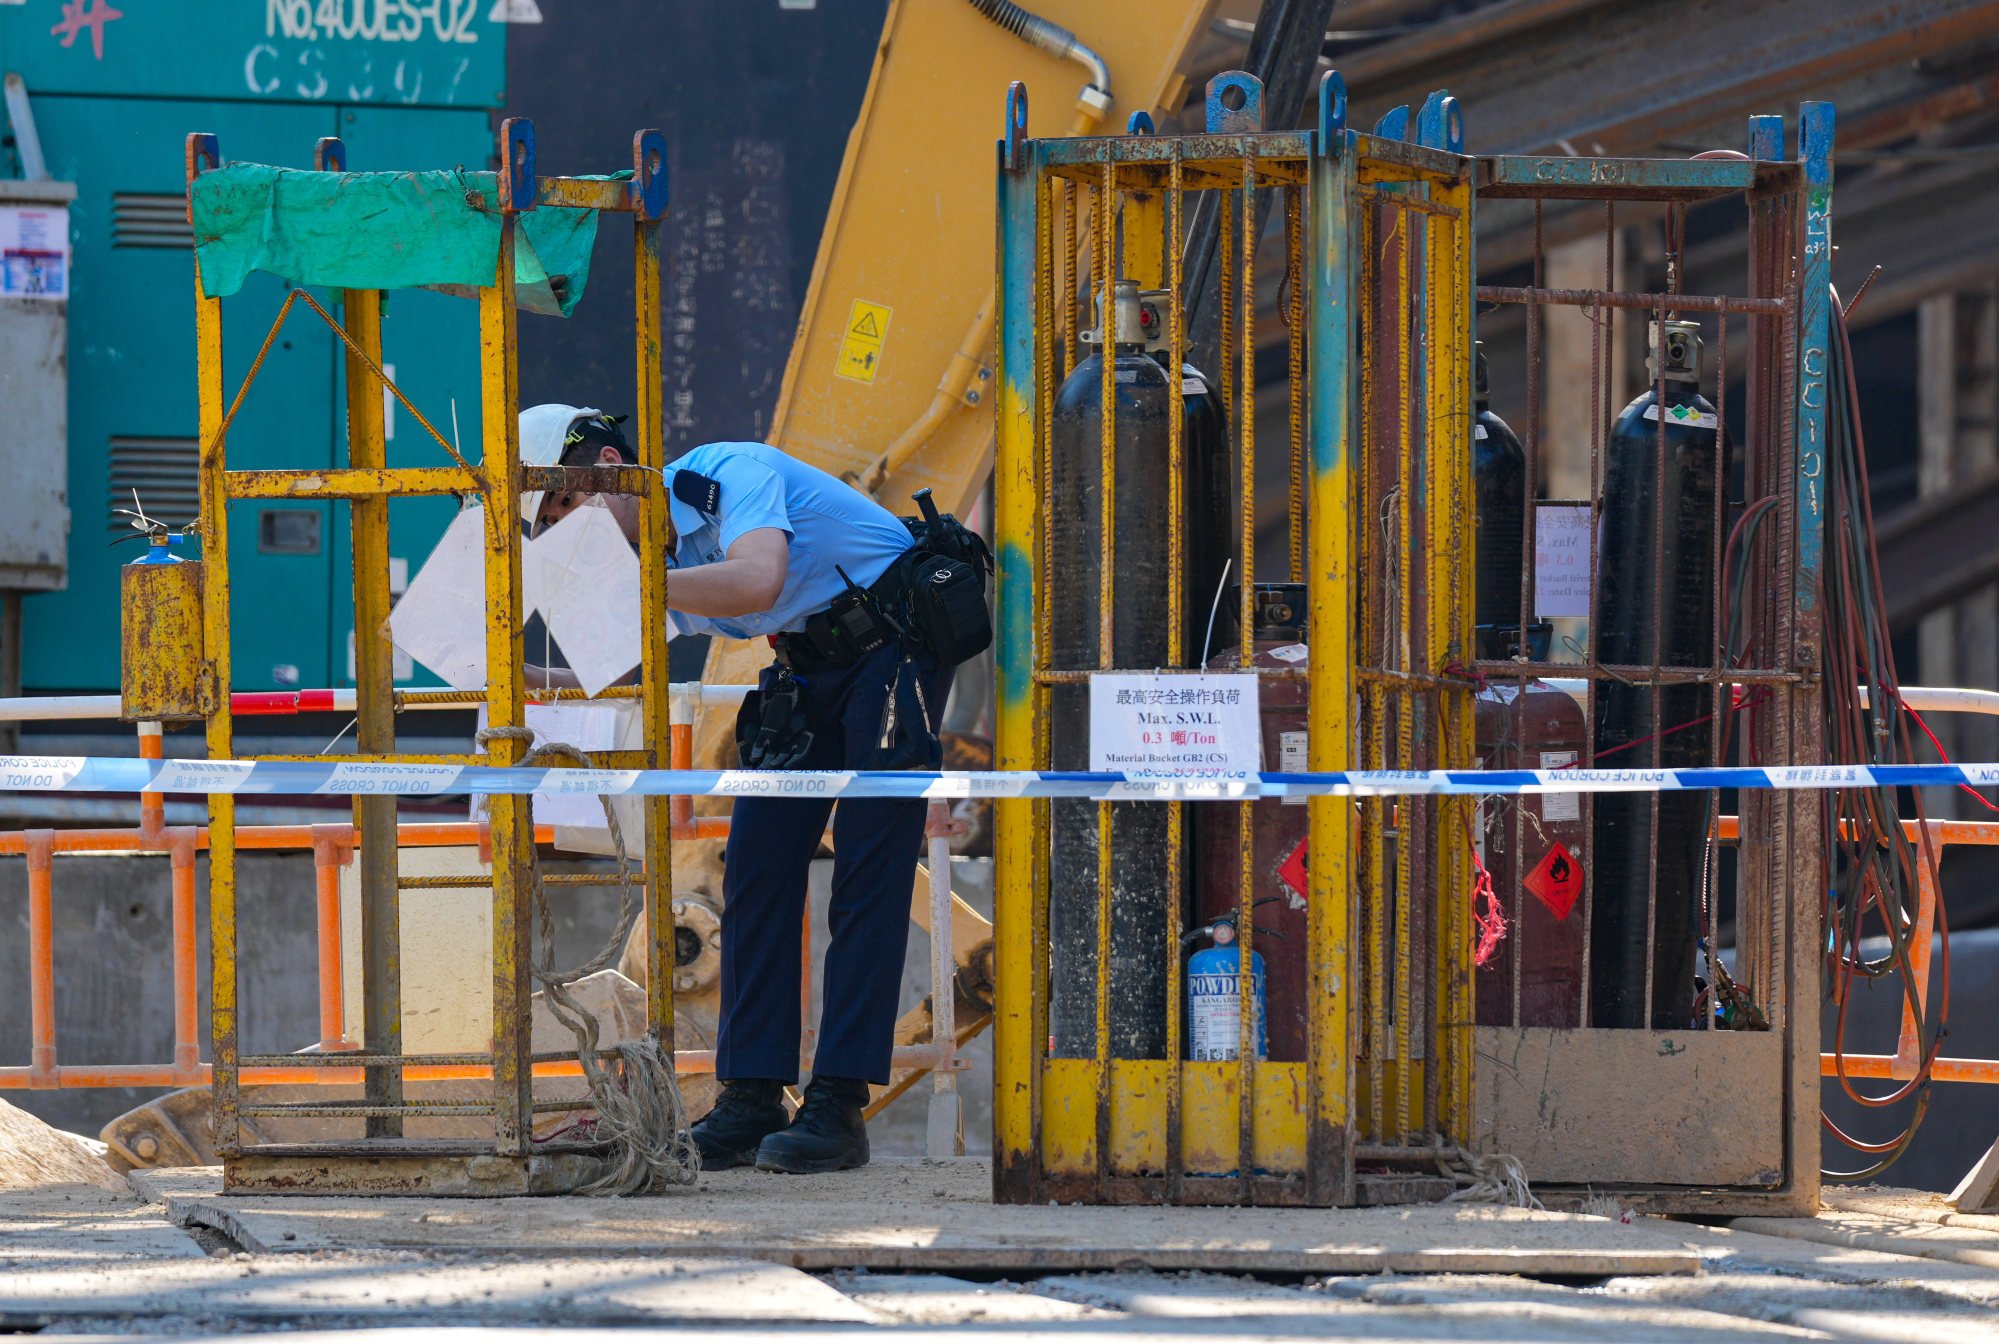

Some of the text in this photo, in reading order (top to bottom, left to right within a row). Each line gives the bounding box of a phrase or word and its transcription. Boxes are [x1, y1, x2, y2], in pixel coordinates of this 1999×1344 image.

[706, 483, 716, 510] 61490
[1116, 688, 1241, 705] 最高安全操作負荷
[1137, 712, 1221, 725] Max. S.W.L.
[1142, 732, 1162, 744] 0.3
[1106, 753, 1228, 764] Material Bucket GB2 (CS)
